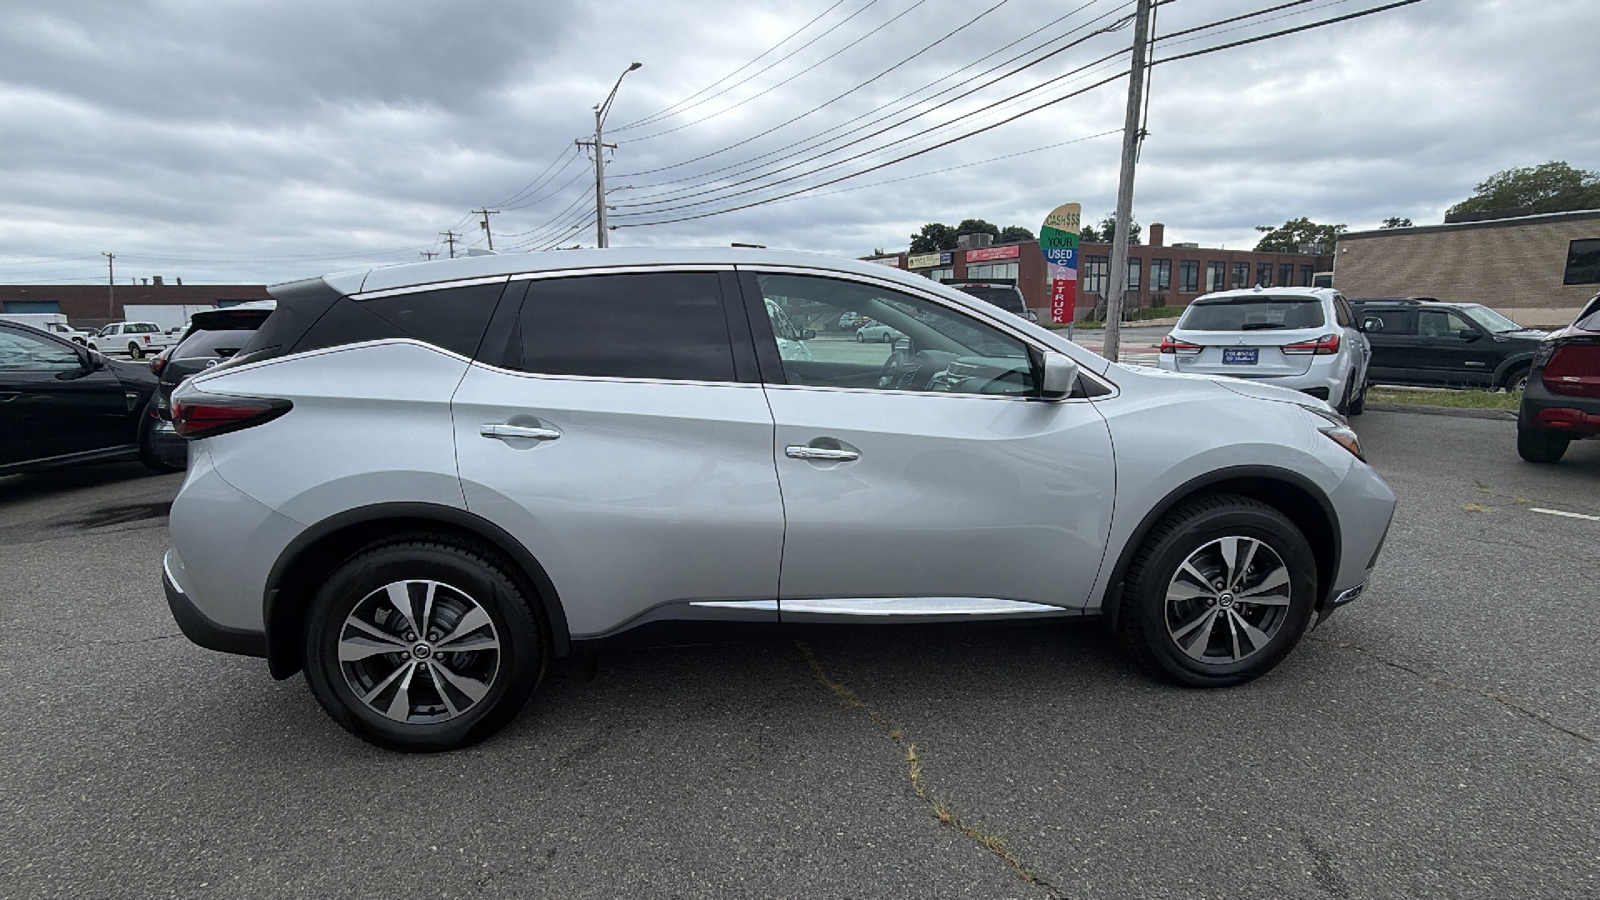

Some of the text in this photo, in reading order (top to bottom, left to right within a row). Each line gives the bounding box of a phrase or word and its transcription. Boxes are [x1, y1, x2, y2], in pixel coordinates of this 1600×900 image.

[1047, 213, 1080, 227] CASH$$$
[1048, 237, 1072, 247] YOUR
[1048, 249, 1073, 259] USED
[1053, 286, 1066, 322] TRUCK
